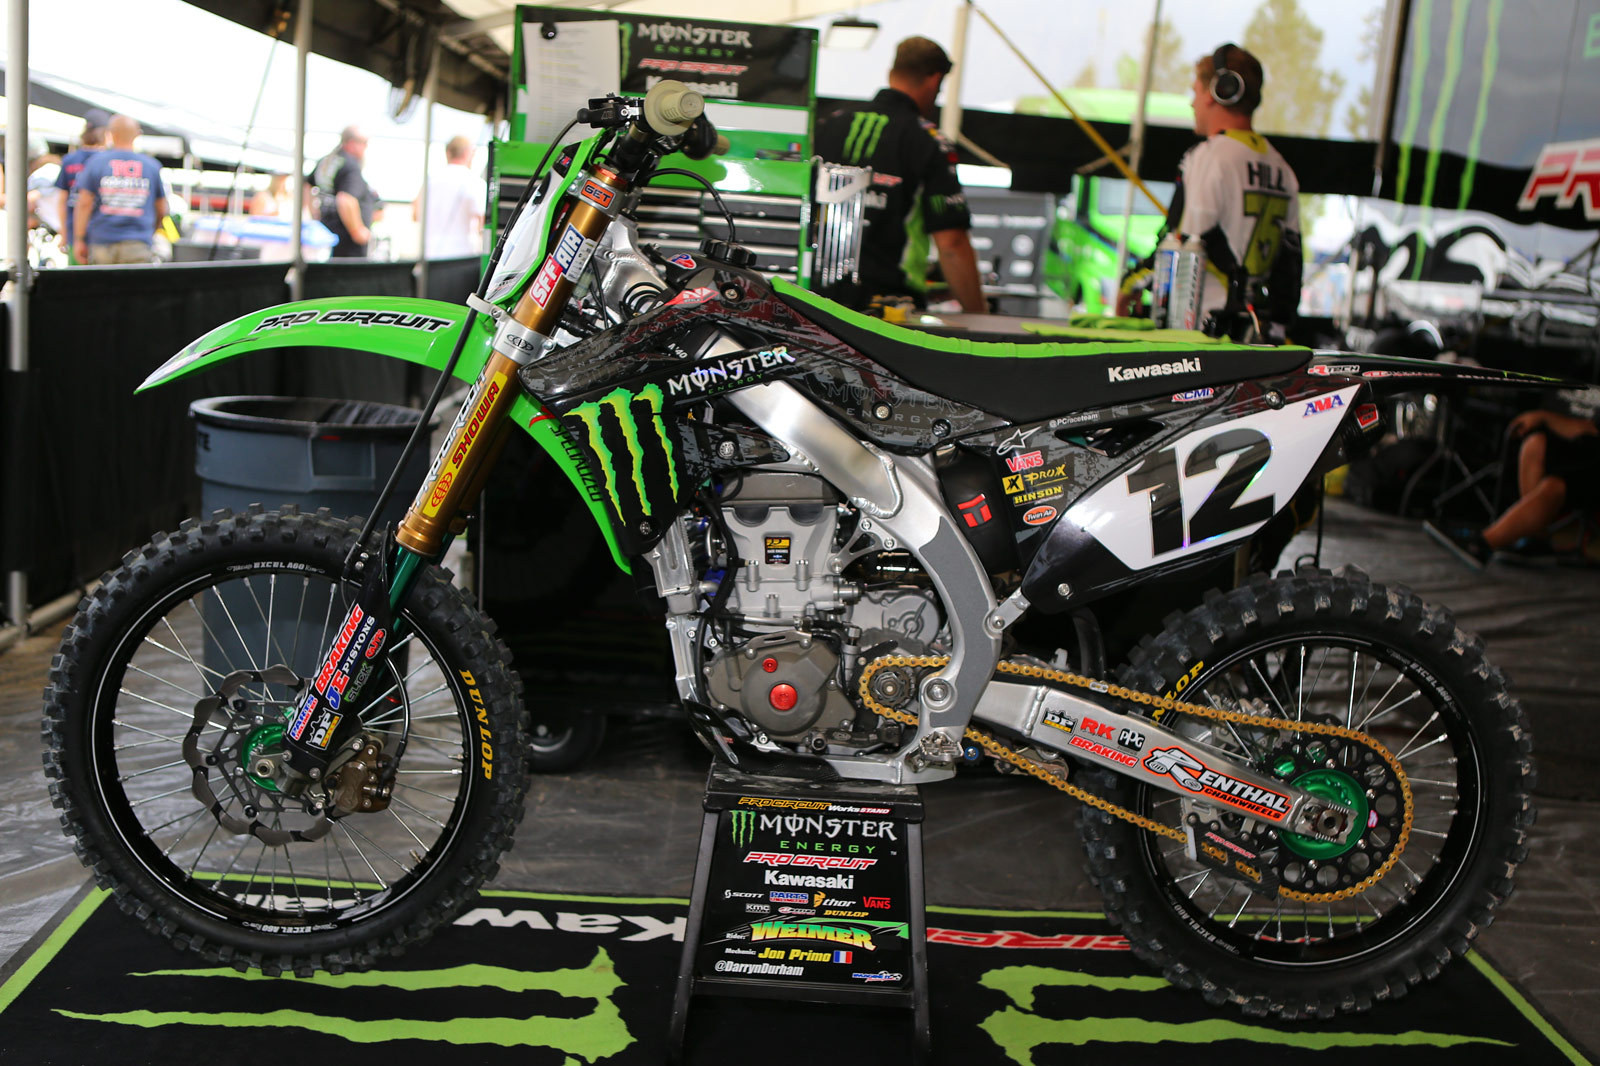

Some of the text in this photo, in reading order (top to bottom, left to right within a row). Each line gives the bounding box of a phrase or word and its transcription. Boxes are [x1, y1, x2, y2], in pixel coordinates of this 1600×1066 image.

[637, 22, 752, 49] MONSTER
[1247, 161, 1287, 192] HILL
[584, 184, 611, 203] GET
[531, 259, 561, 305] SFF
[556, 229, 583, 269] AIR
[249, 310, 454, 335] PRO CIRCUIT
[667, 346, 796, 396] MONSTER
[1108, 358, 1201, 383] Kawasaki
[846, 408, 937, 425] ENRGY
[1303, 394, 1345, 417] AMA
[451, 381, 500, 469] SHOWA
[1006, 451, 1044, 473] VANS
[1014, 486, 1062, 504] HINSON
[1125, 427, 1276, 558] 12
[315, 603, 364, 695] BRAKING
[325, 615, 375, 710] JE PISTONS
[312, 711, 332, 746] DP
[459, 669, 493, 780] DUNLOP
[1080, 717, 1116, 740] RK
[1069, 736, 1138, 768] BRAKING
[1204, 787, 1282, 819] CHAINWHEELS
[759, 813, 898, 842] MONSTER
[780, 840, 876, 854] ENERGY
[743, 851, 878, 870] PRO CIRCUIT
[764, 869, 854, 890] Kawasaki
[731, 891, 765, 899] SCOTT
[769, 891, 809, 899] PARTS
[822, 898, 857, 908] thor
[863, 896, 892, 910] VANS
[823, 909, 870, 918] DUNLOP
[750, 920, 877, 951] WEIMER
[757, 947, 785, 960] Jon
[788, 949, 832, 963] Primo
[715, 960, 804, 976] @DarrynDurham
